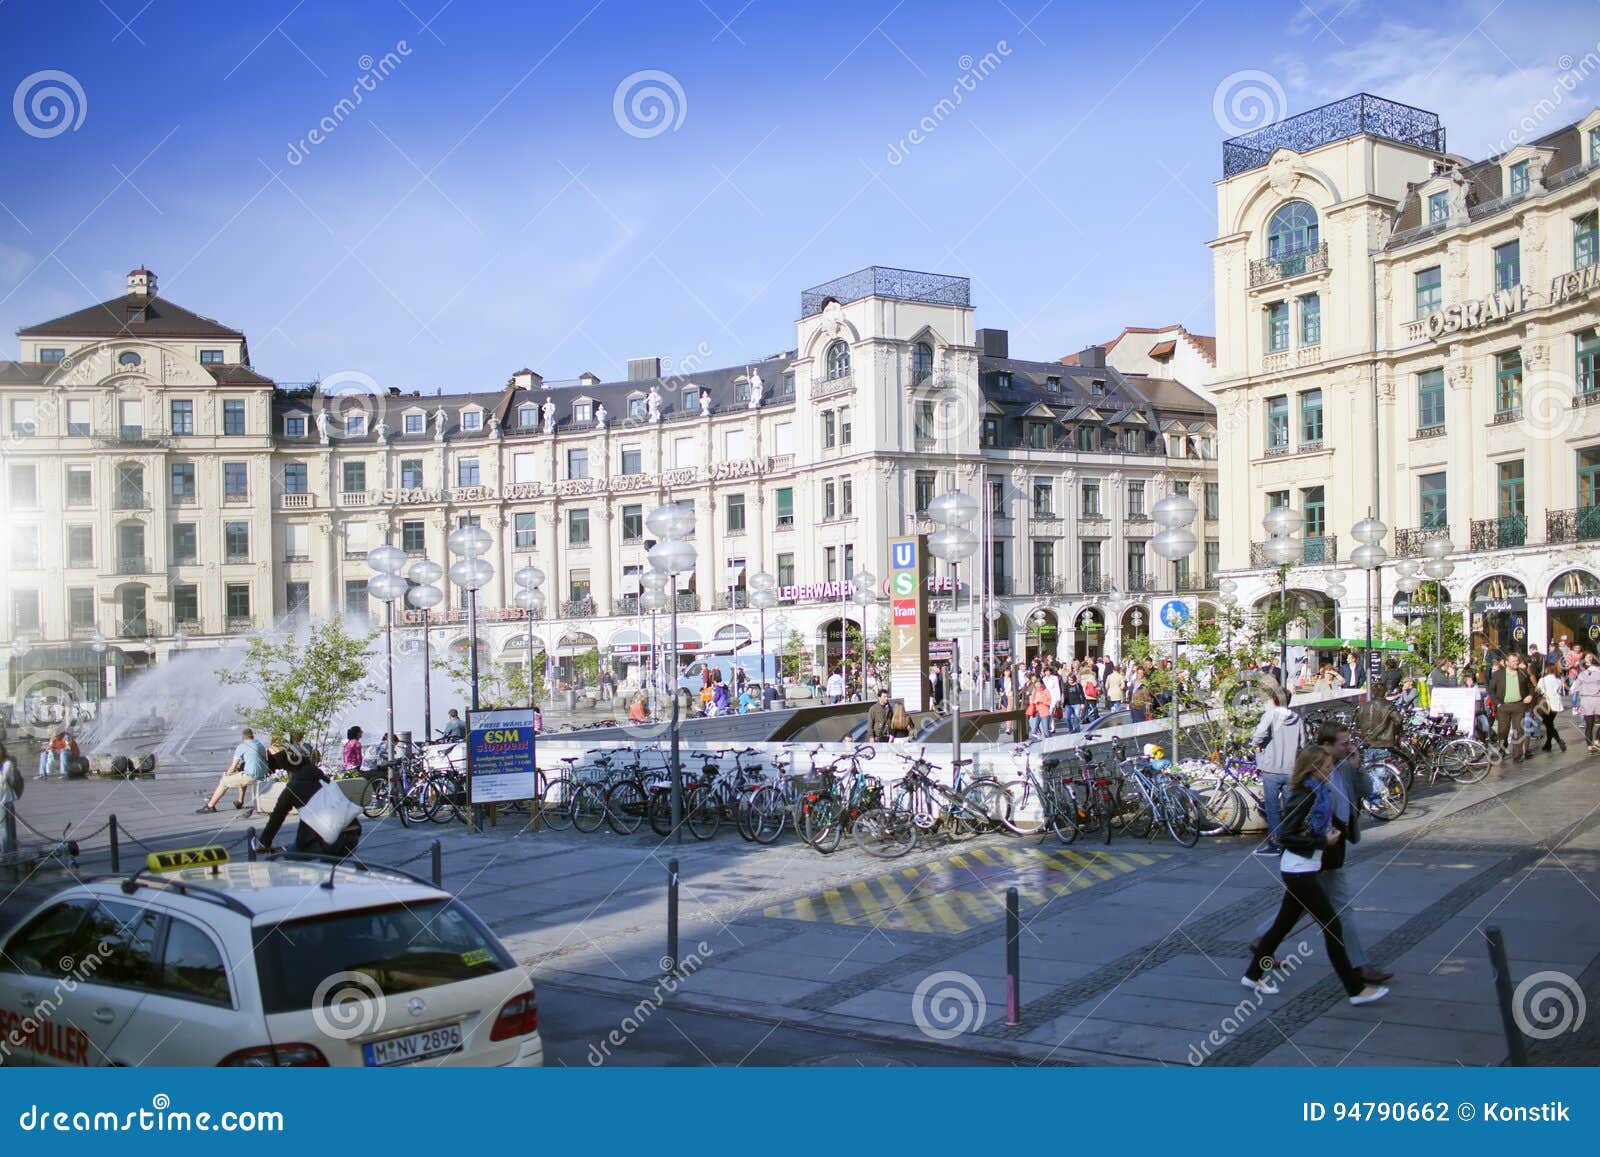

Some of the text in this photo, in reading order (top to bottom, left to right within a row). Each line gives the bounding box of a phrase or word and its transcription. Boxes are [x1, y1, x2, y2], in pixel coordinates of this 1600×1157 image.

[1425, 284, 1522, 338] OSRAM
[706, 458, 770, 480] OSRAM
[369, 486, 442, 506] OSRAM
[896, 544, 911, 566] U
[777, 578, 857, 600] LEDERWAREN
[896, 572, 913, 596] S
[894, 606, 916, 617] Tram
[166, 848, 219, 866] TAXI
[375, 1027, 460, 1062] M NV 2896
